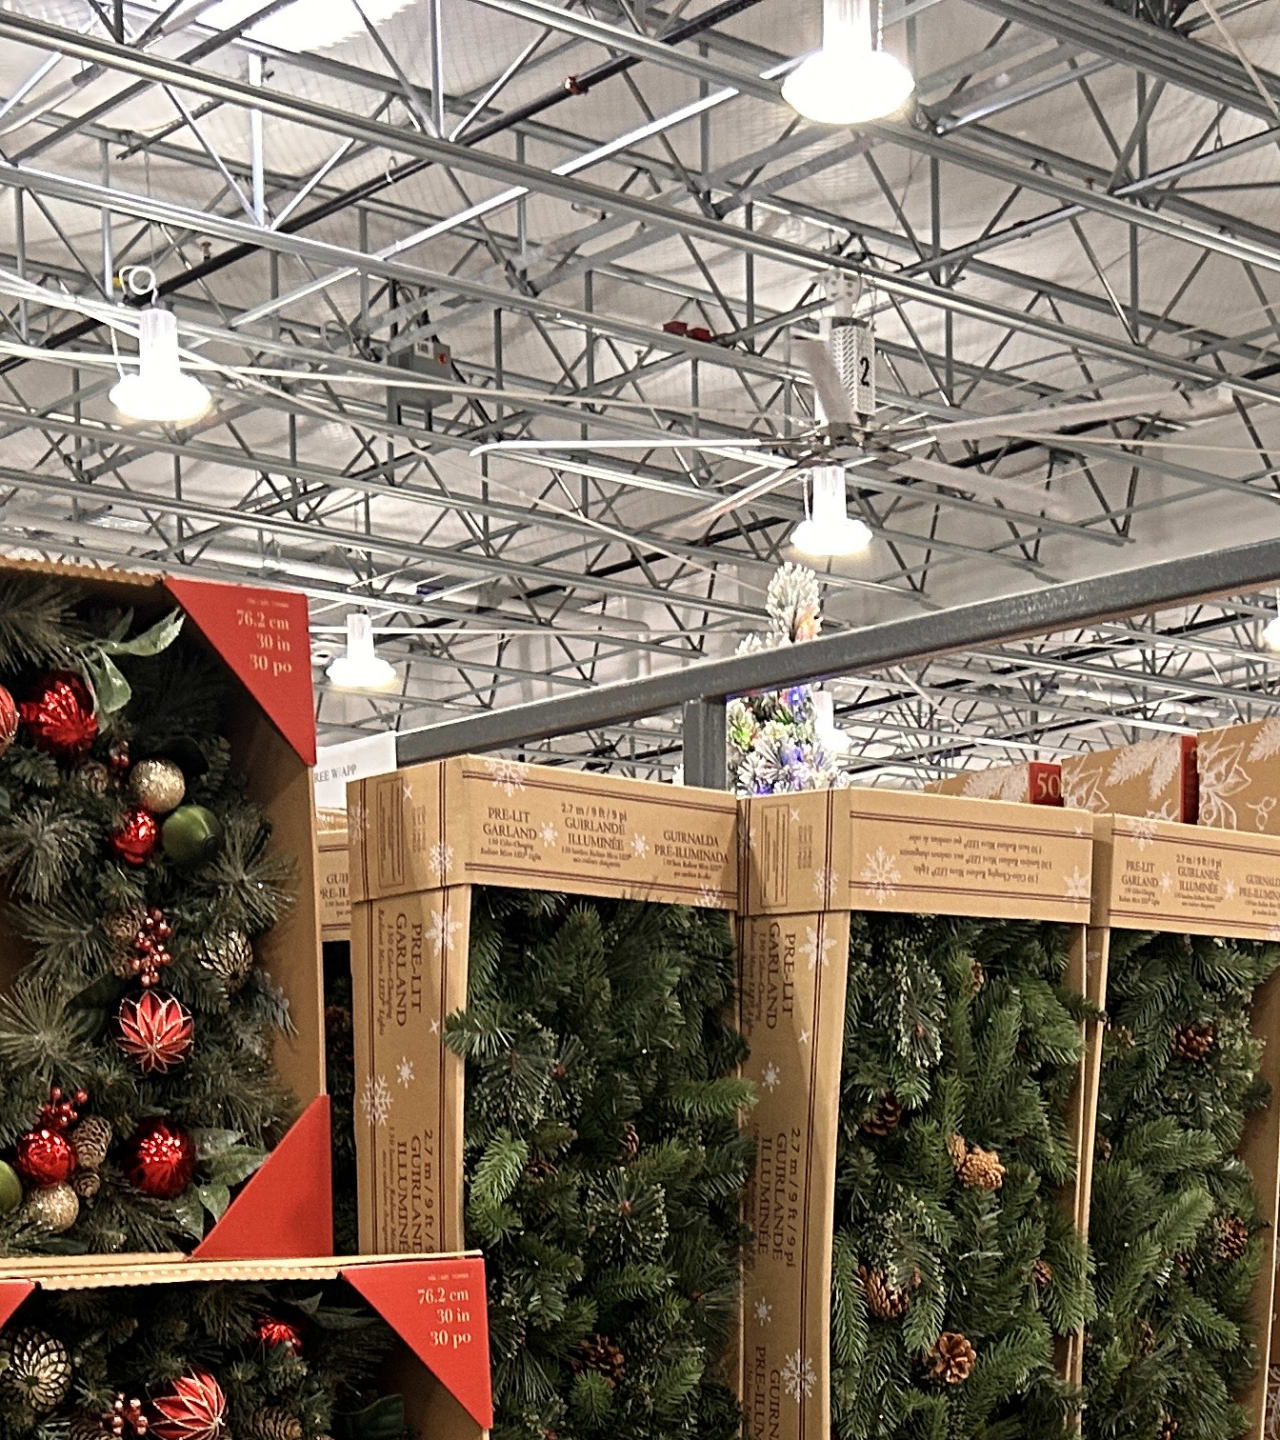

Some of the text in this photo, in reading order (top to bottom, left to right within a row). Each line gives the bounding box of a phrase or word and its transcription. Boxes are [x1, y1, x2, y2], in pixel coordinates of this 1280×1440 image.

[236, 609, 289, 631] 76.2 cm
[256, 633, 290, 652] 30 in
[249, 654, 292, 677] 30 po
[314, 770, 330, 784] REE
[1037, 772, 1060, 799] 50
[488, 807, 530, 824] PRE-LIT
[482, 823, 537, 841] GARLAND
[564, 817, 625, 835] GUIRLANDE
[567, 833, 624, 851] ILLUMINÉE
[663, 831, 719, 847] GUIRNALDA
[655, 844, 730, 864] PRE-ILUMINADA
[1126, 859, 1155, 873] PRE-LIT
[1177, 866, 1220, 881] GUIRLANDE
[1121, 874, 1159, 888] GARLAND
[396, 913, 407, 1027] GARLAND
[411, 923, 423, 1013] PRE-LIT
[766, 922, 780, 1030] GARLAND
[783, 933, 796, 1019] PRE-LIT
[424, 1129, 433, 1156] 2.7
[424, 1162, 432, 1180] m
[397, 1141, 411, 1254] ILLUMINÉ
[758, 1136, 772, 1255] ILLUMINÉE
[773, 1132, 787, 1261] GUIRLANDE
[784, 1127, 800, 1268] 2.7 m / 9 ft / 9 pi
[425, 1214, 434, 1228] ft
[417, 1287, 469, 1305] 76.2 cm
[436, 1307, 470, 1324] 30 in
[430, 1329, 471, 1349] 30 po
